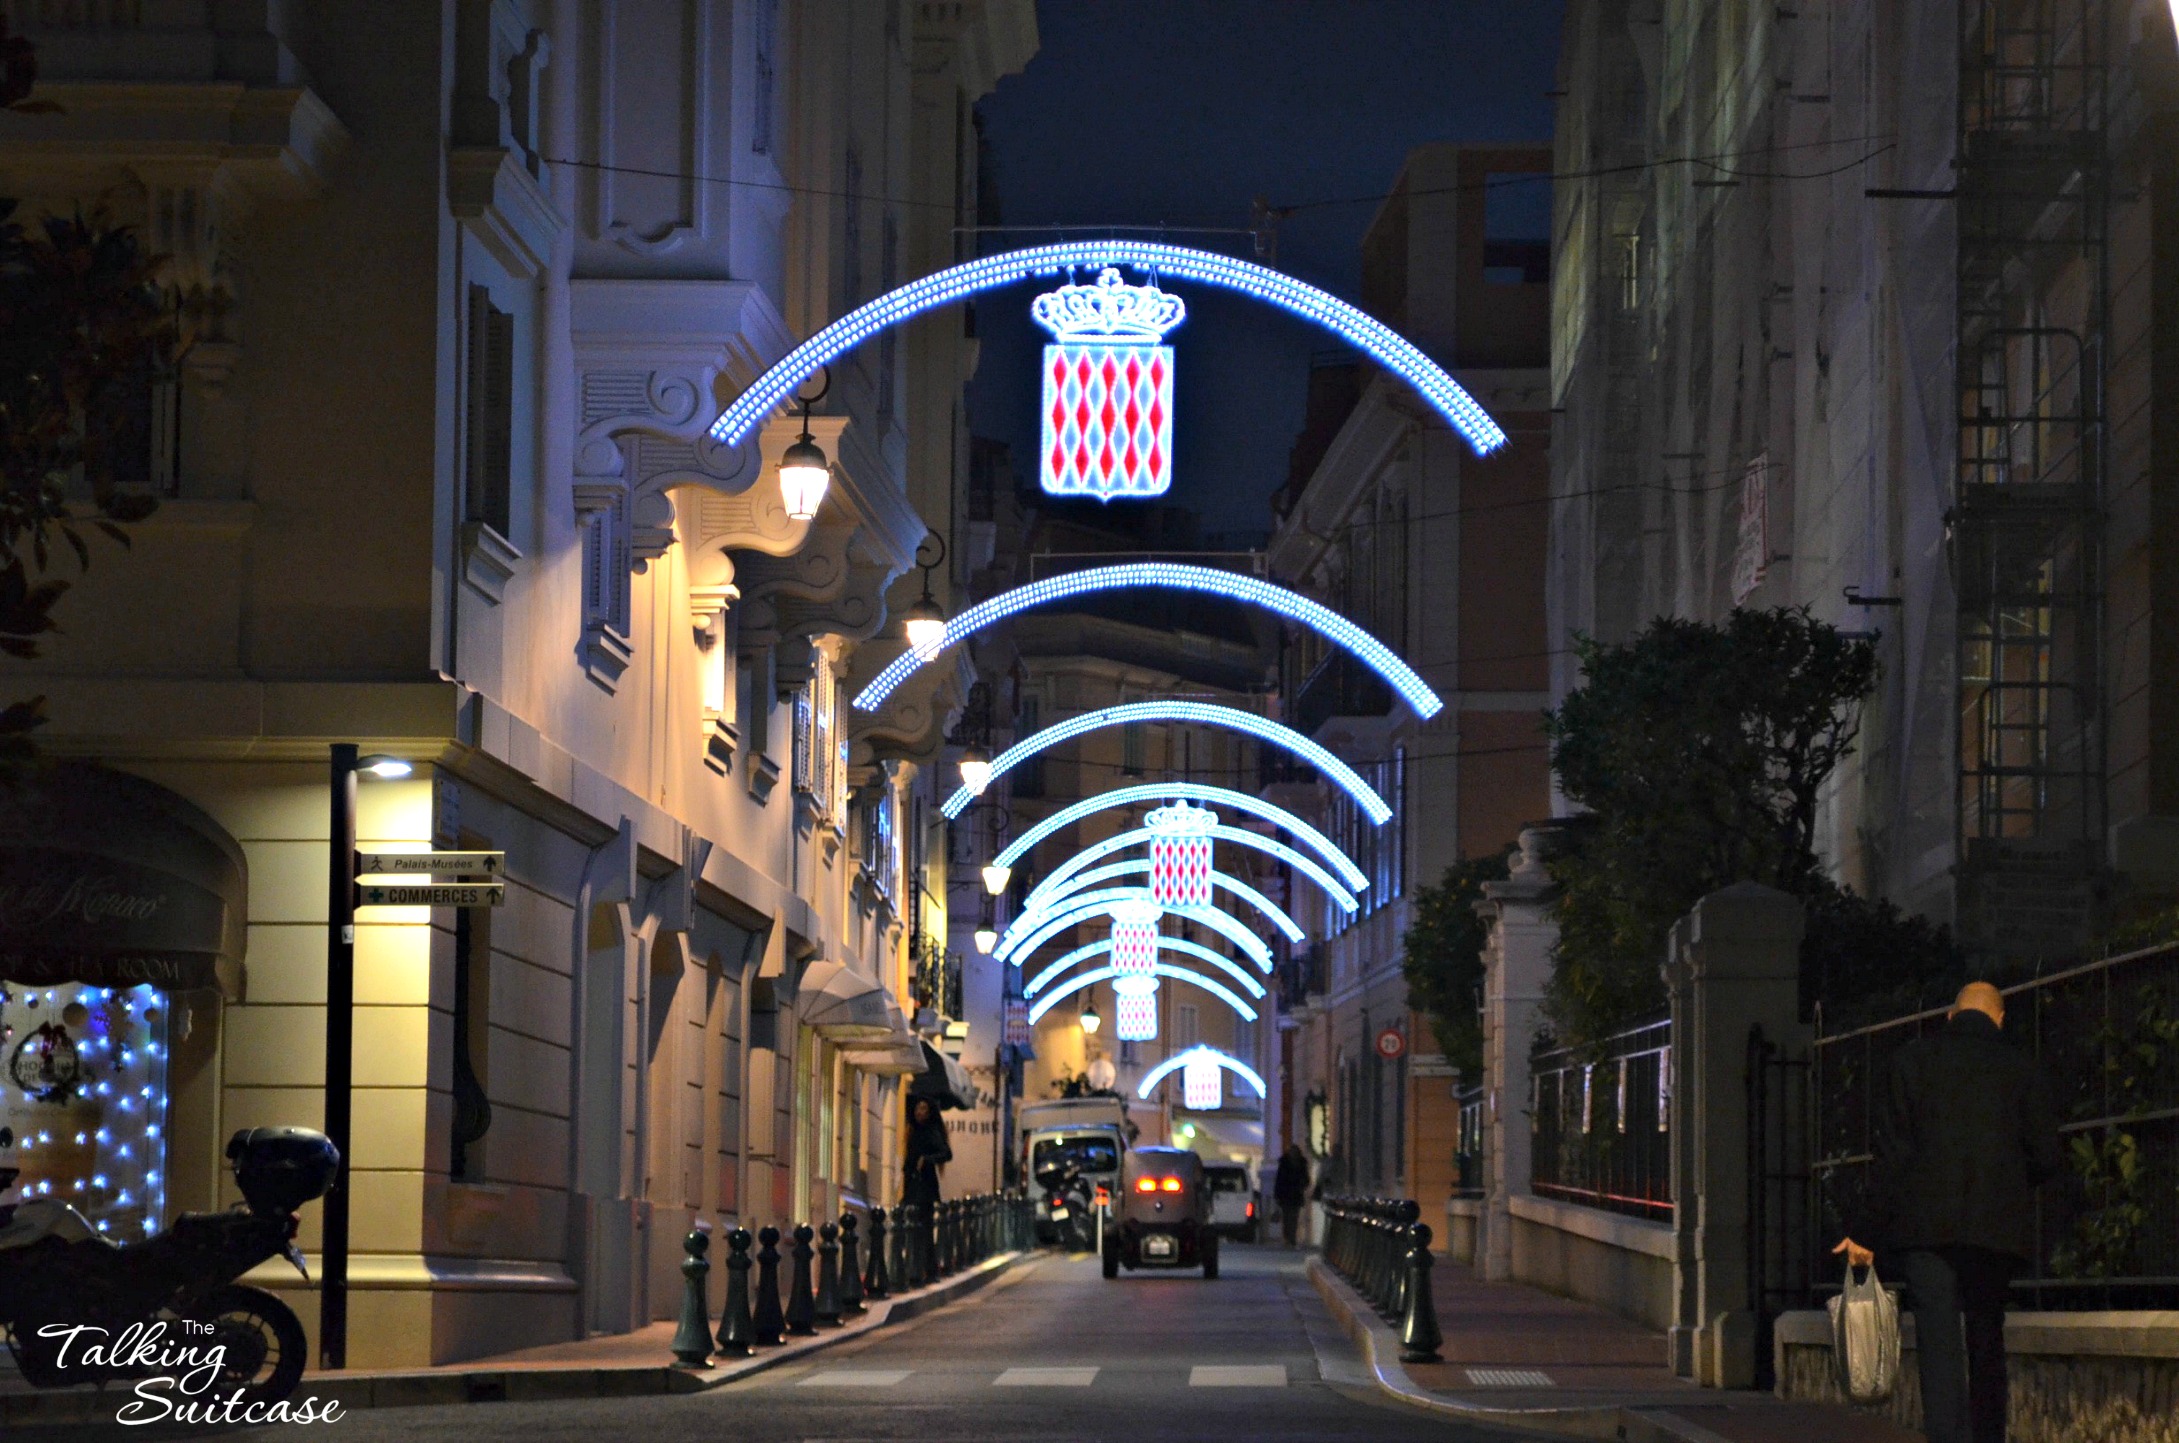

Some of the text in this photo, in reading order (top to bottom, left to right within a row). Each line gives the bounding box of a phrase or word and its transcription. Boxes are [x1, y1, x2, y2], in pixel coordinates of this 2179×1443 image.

[394, 857, 473, 869] Palais-Musées
[388, 888, 478, 904] COMMERCES
[116, 957, 180, 980] ROOM
